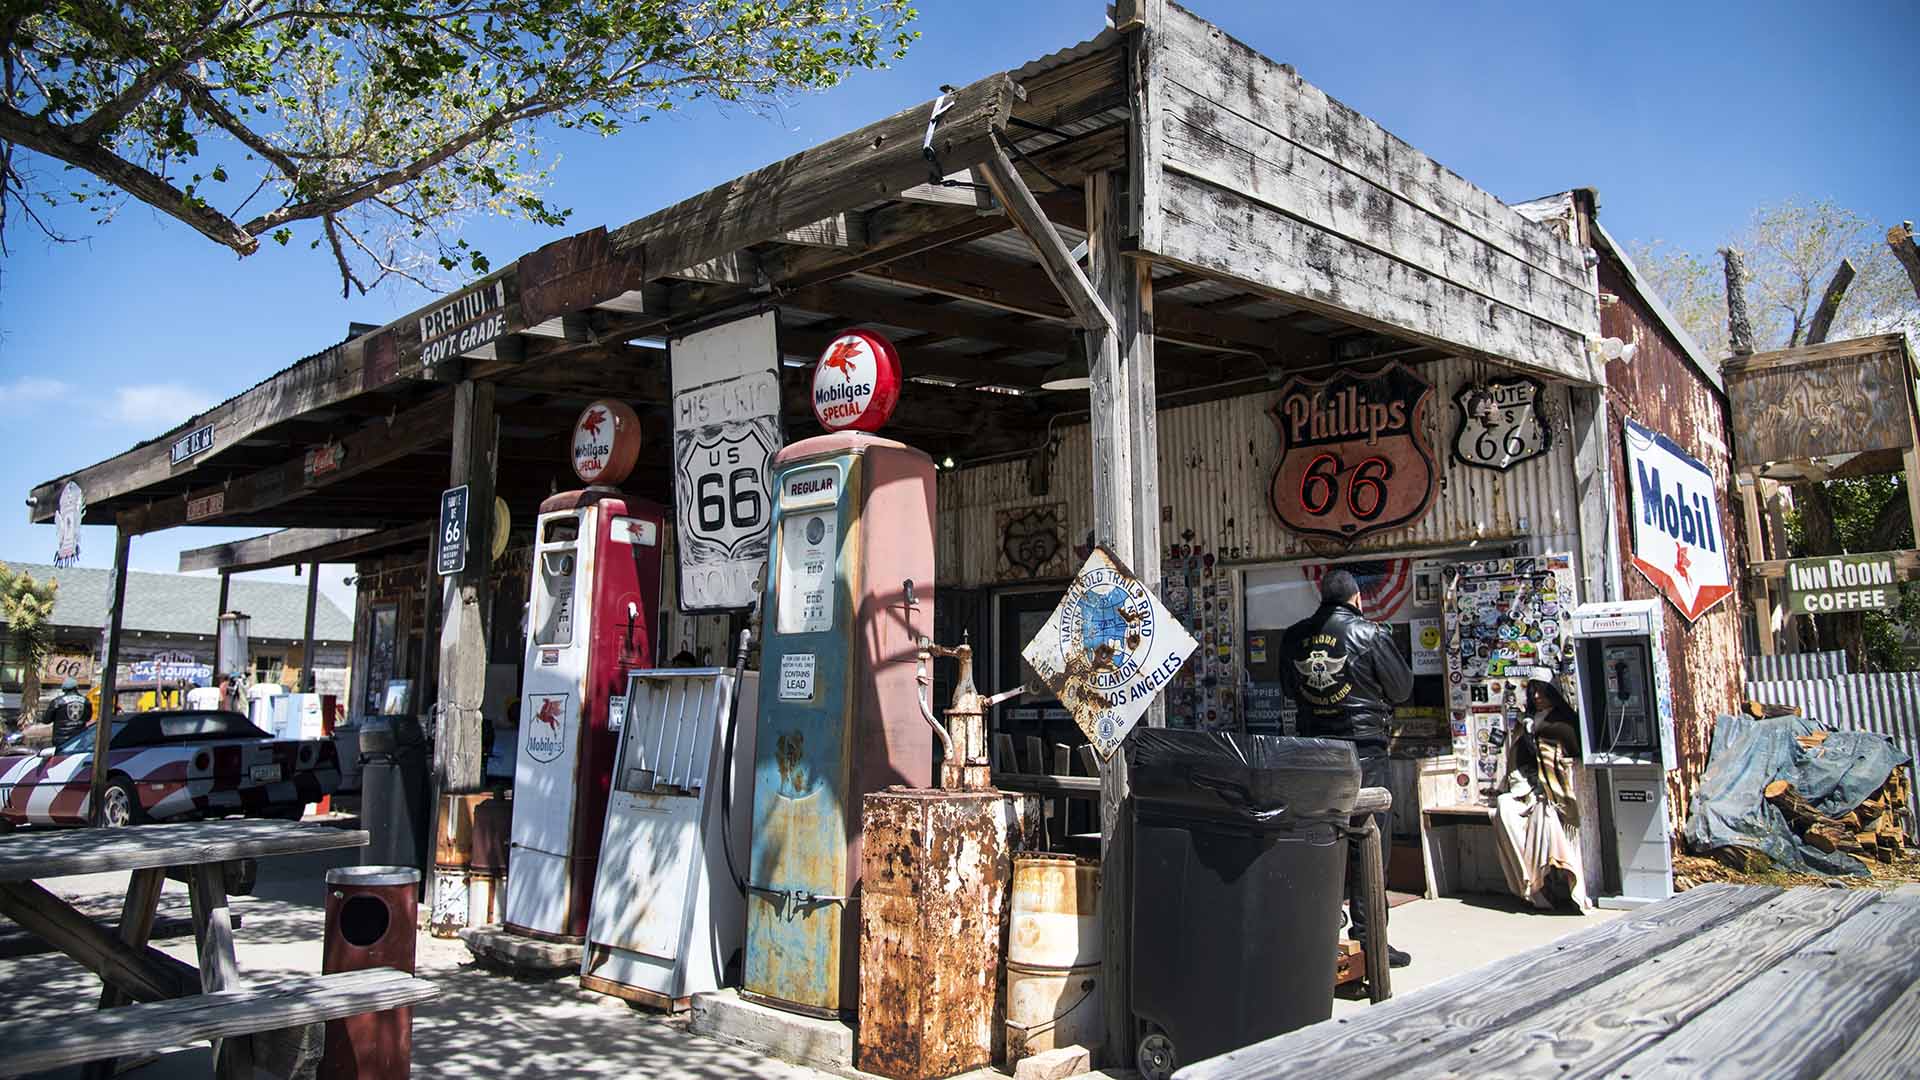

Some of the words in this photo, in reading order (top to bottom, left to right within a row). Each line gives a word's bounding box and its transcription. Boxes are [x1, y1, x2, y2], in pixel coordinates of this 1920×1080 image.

[424, 285, 498, 340] PREMIUM
[460, 314, 503, 351] GRADE
[815, 382, 870, 404] Mobilgas
[822, 401, 862, 421] SPECIAL
[1284, 386, 1405, 447] Phillips
[1475, 424, 1525, 460] 66
[697, 467, 760, 532] 66
[791, 477, 833, 496] REGULAR
[1301, 453, 1393, 522] 66
[1637, 457, 1717, 553] Mobil
[445, 519, 460, 543] 66
[1790, 562, 1828, 591] INN
[1829, 560, 1893, 587] ROOM
[1085, 571, 1104, 589] OLD
[1107, 571, 1143, 600] TRAILS
[1138, 600, 1152, 637] ROAD
[1803, 589, 1886, 611] COFFEE
[1592, 620, 1627, 630] frontier
[55, 658, 81, 678] 66
[1130, 652, 1182, 702] ANGELES
[786, 679, 807, 689] LEAD
[529, 736, 563, 756] Mobilgas
